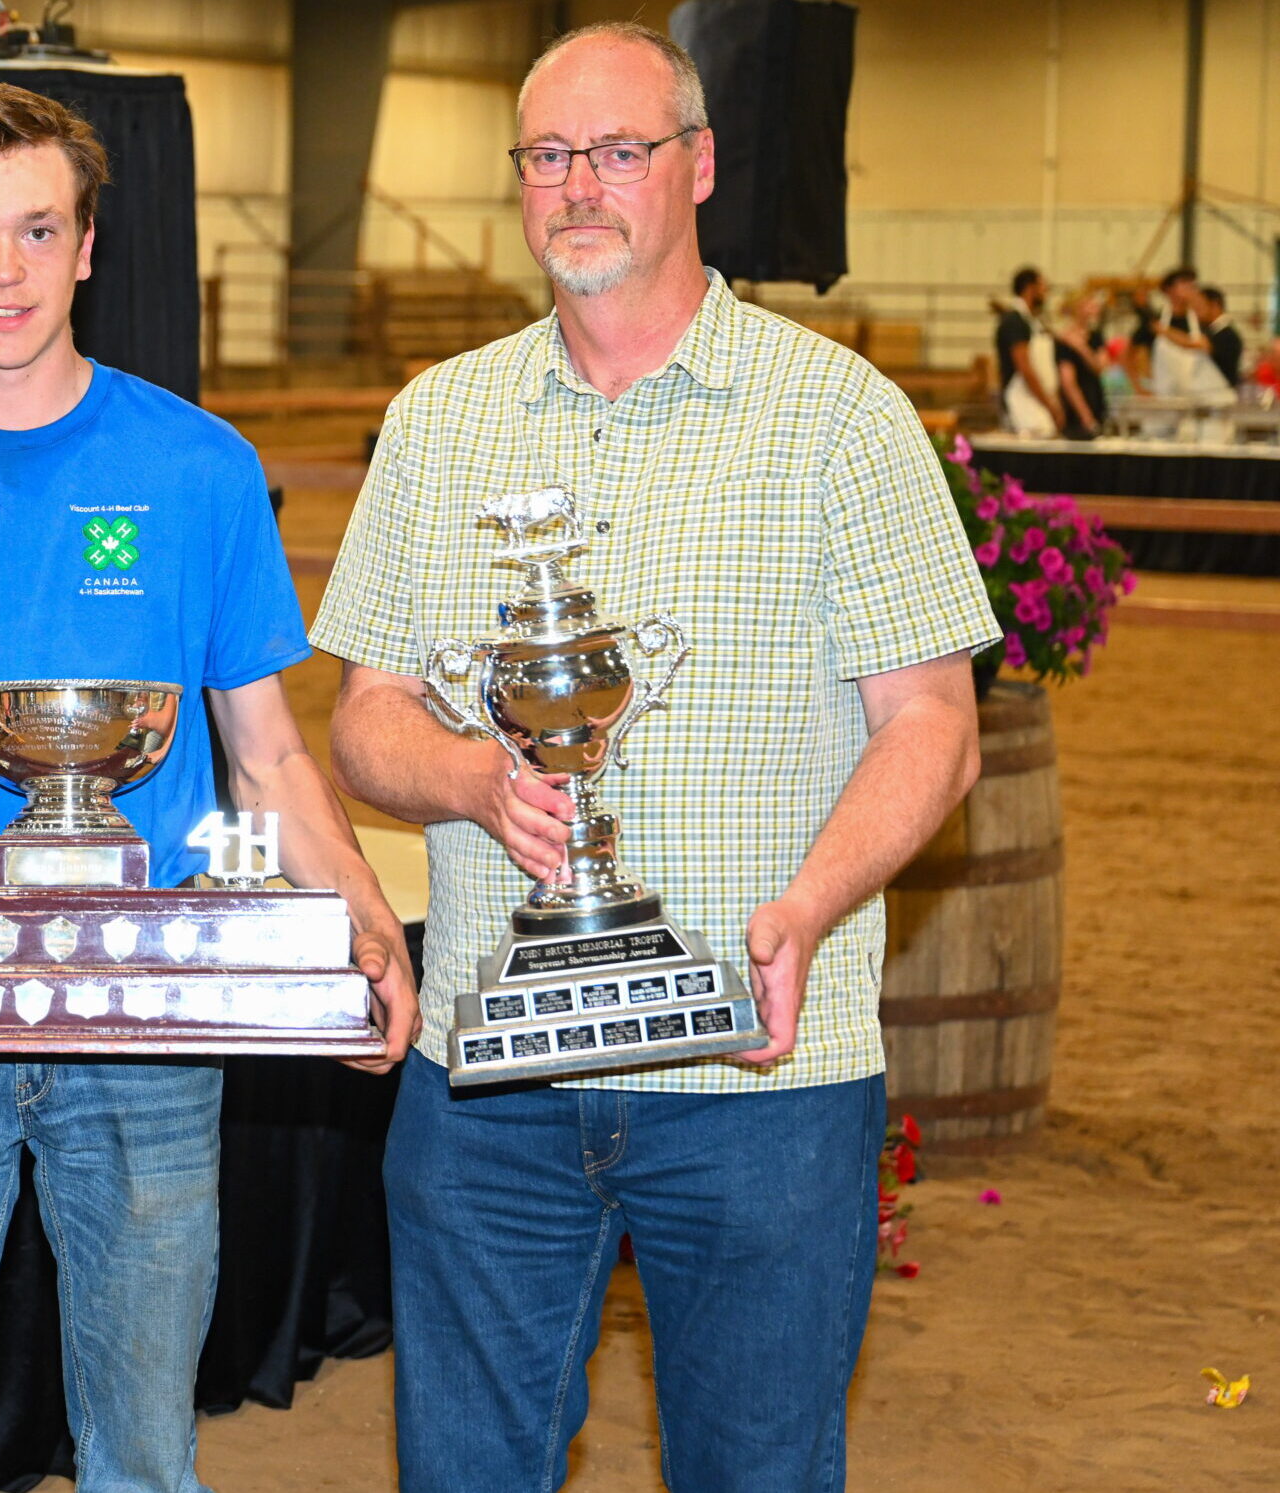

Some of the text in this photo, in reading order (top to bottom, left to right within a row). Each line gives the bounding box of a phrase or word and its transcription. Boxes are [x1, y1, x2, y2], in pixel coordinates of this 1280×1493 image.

[69, 504, 100, 513] Viscount
[115, 504, 132, 512] Beef
[84, 578, 138, 586] CANADA
[517, 932, 666, 961] JOHN BRUCE MEMORIAL TROPHY
[528, 946, 657, 971] Supreme Showmanship Award
